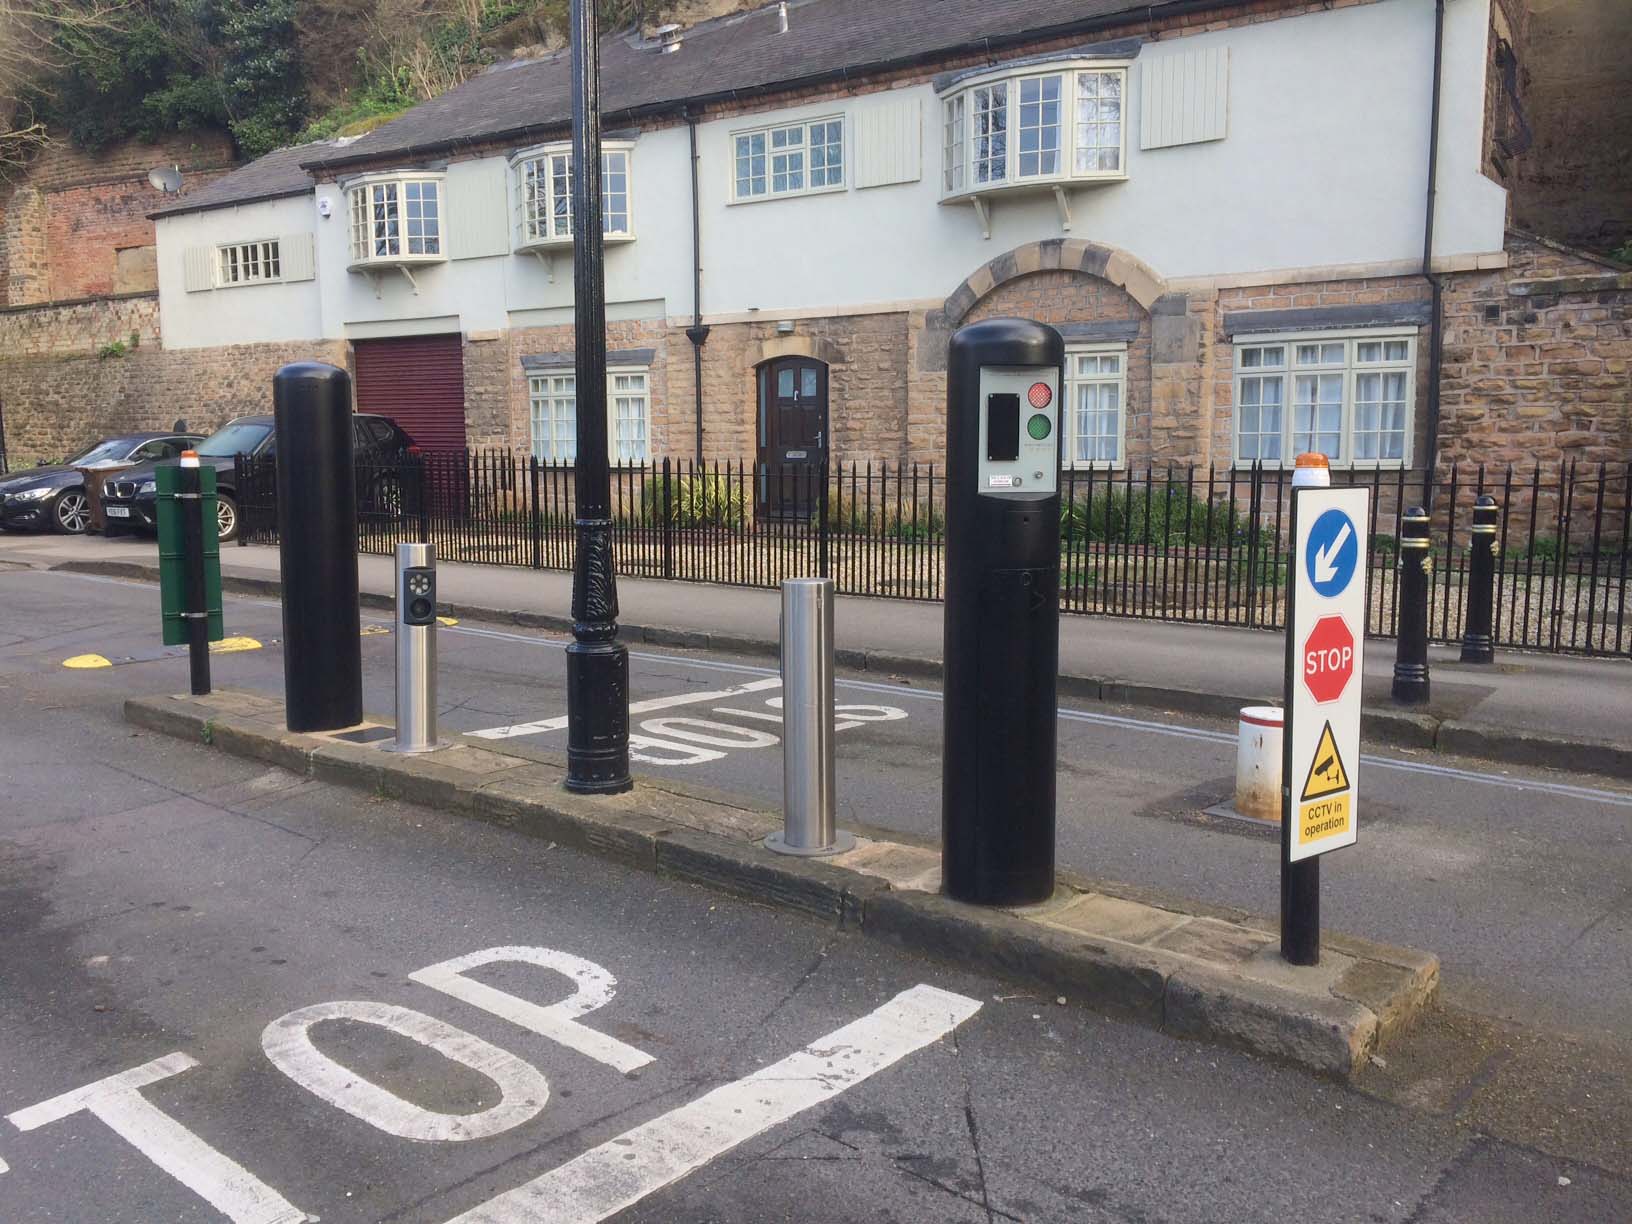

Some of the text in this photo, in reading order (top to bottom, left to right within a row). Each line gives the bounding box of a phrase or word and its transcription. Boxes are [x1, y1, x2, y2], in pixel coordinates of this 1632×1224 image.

[1306, 646, 1352, 675] STOP
[1308, 800, 1342, 821] CCTV in
[1305, 816, 1344, 836] operation
[0, 946, 656, 1224] TOP
